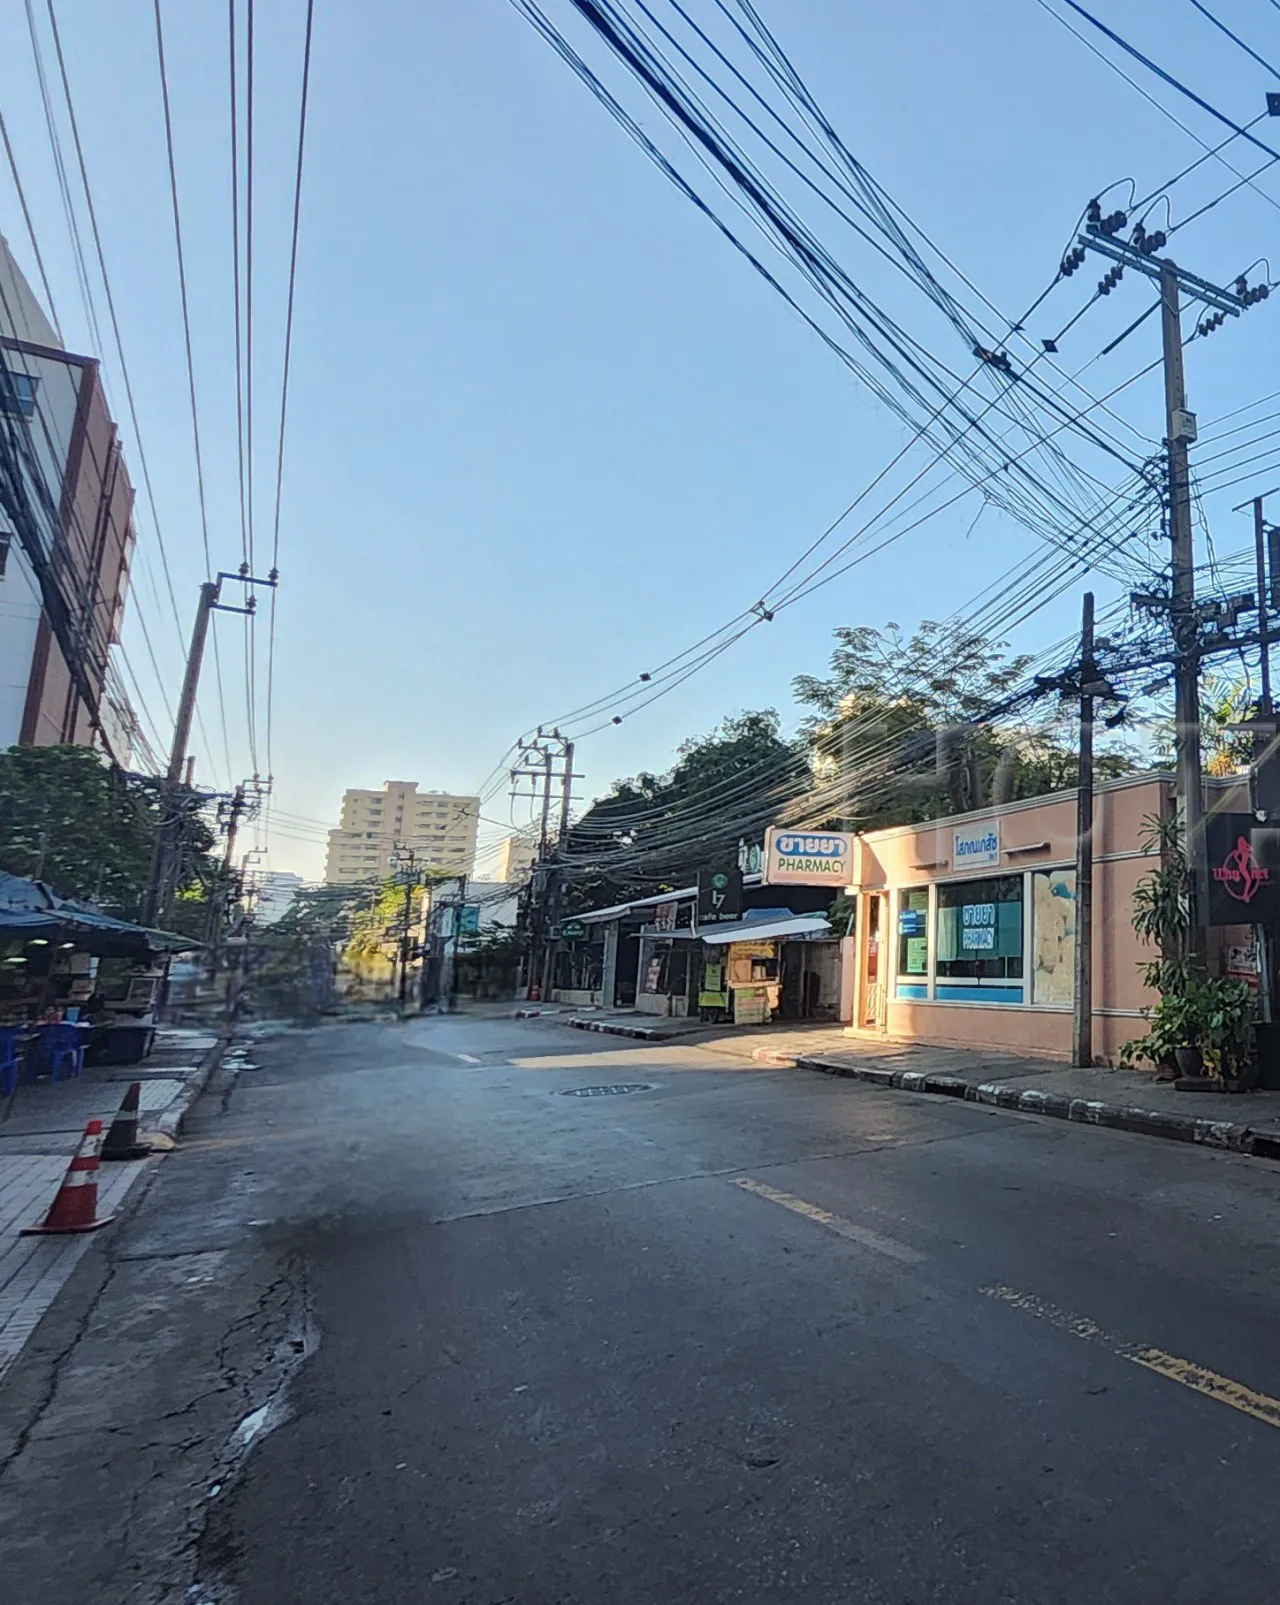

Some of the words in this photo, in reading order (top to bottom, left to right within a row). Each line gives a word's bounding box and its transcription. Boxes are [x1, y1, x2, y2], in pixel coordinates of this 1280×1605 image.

[780, 836, 845, 854] ขายยา
[778, 857, 847, 873] PHARMACY
[962, 903, 996, 926] ขายยา
[962, 927, 996, 950] PHARMACY
